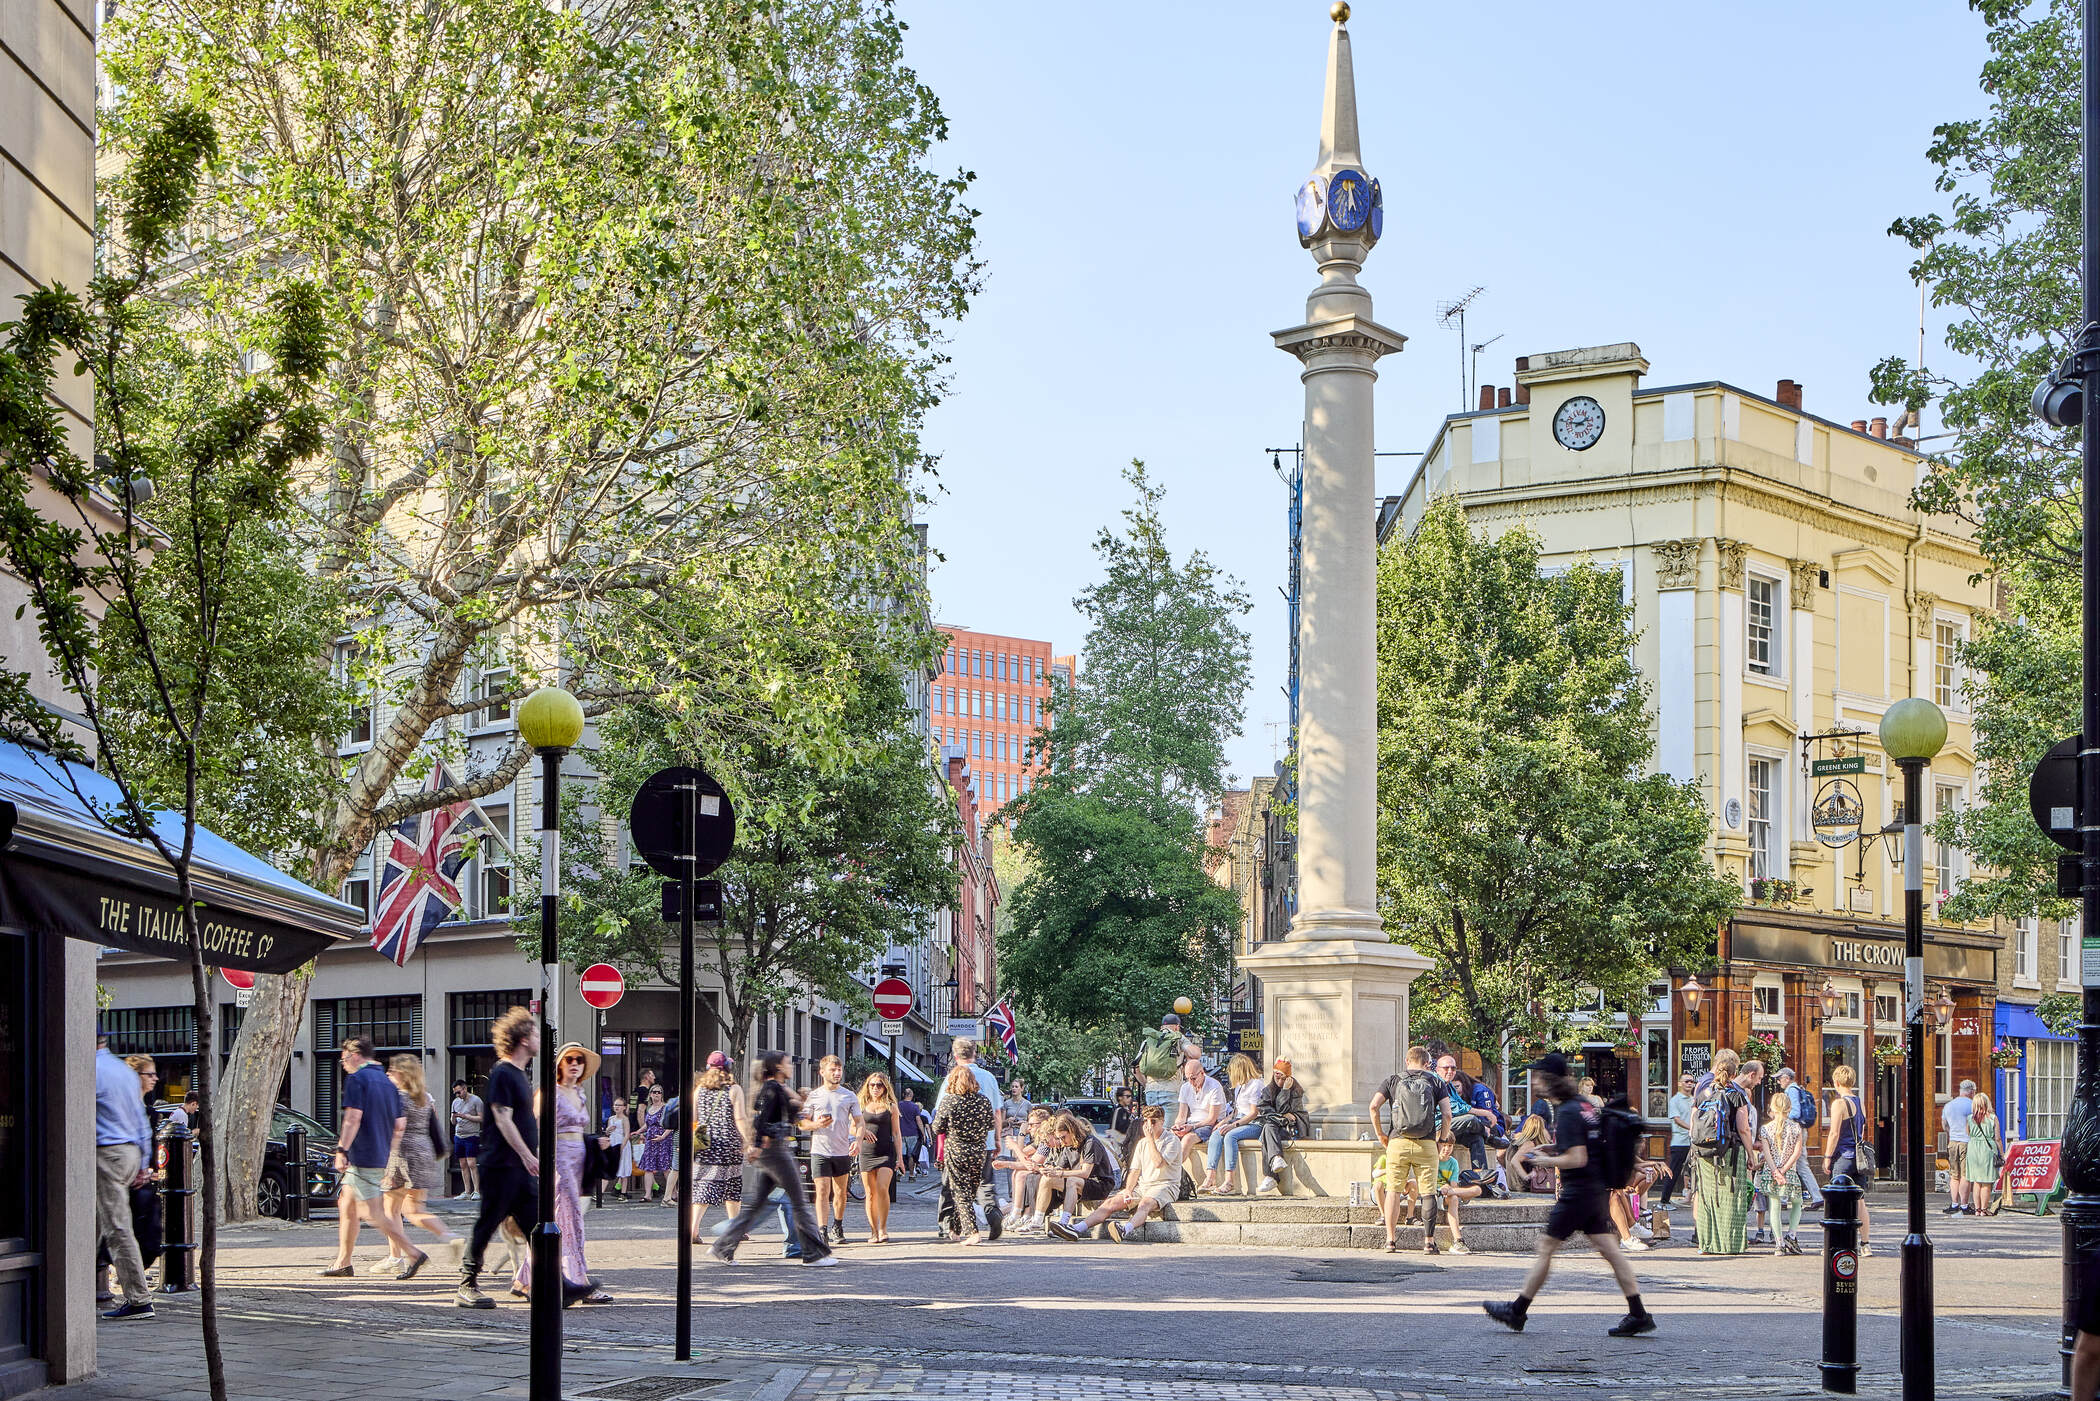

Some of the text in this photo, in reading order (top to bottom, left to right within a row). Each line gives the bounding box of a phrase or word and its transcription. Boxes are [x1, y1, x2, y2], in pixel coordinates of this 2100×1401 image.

[1842, 762, 1859, 770] KING
[1832, 833, 1853, 841] CROWN
[100, 896, 131, 933] THE
[138, 905, 190, 946] ITALIA
[203, 922, 254, 958] COFFEE
[1834, 940, 1906, 966] THE CROW
[1684, 1046, 1709, 1054] PROPER
[1690, 1060, 1703, 1068] WITH
[2023, 1145, 2051, 1155] ROAD
[2014, 1156, 2052, 1166] CLOSED
[2010, 1166, 2049, 1176] ACCESS
[2011, 1177, 2039, 1188] ONLY
